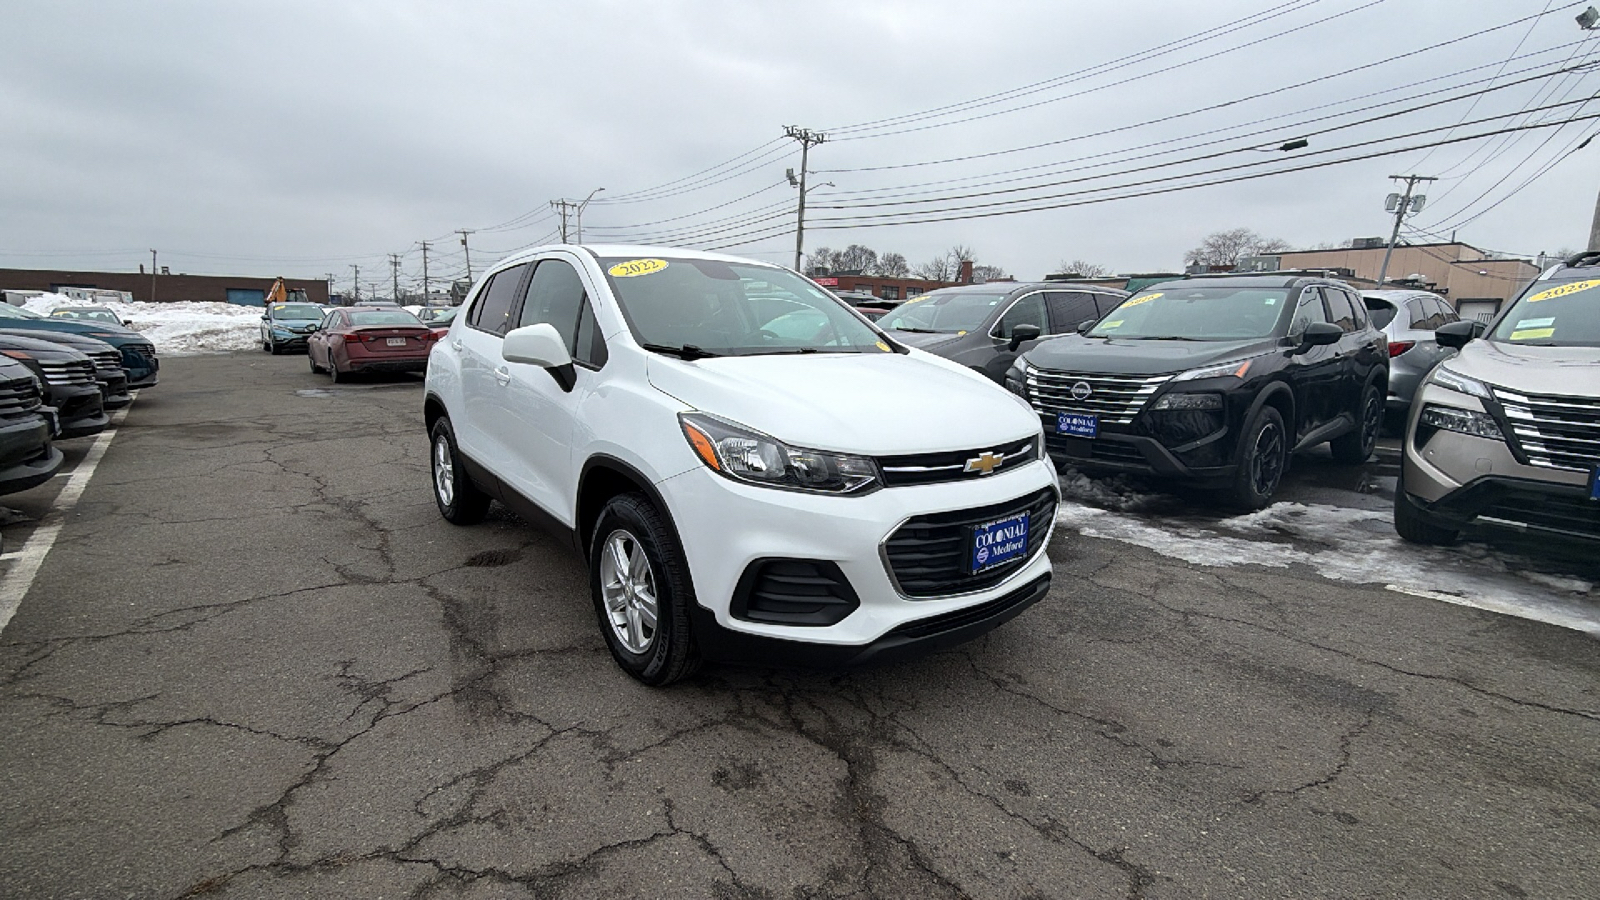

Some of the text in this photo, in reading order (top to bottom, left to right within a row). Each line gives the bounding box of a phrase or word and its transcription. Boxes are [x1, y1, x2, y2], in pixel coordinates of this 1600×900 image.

[619, 260, 659, 275] 2022
[1058, 416, 1096, 427] COLONIAL
[1070, 424, 1094, 434] Medford
[975, 523, 1027, 549] COLONIAL
[991, 538, 1024, 557] Medford
